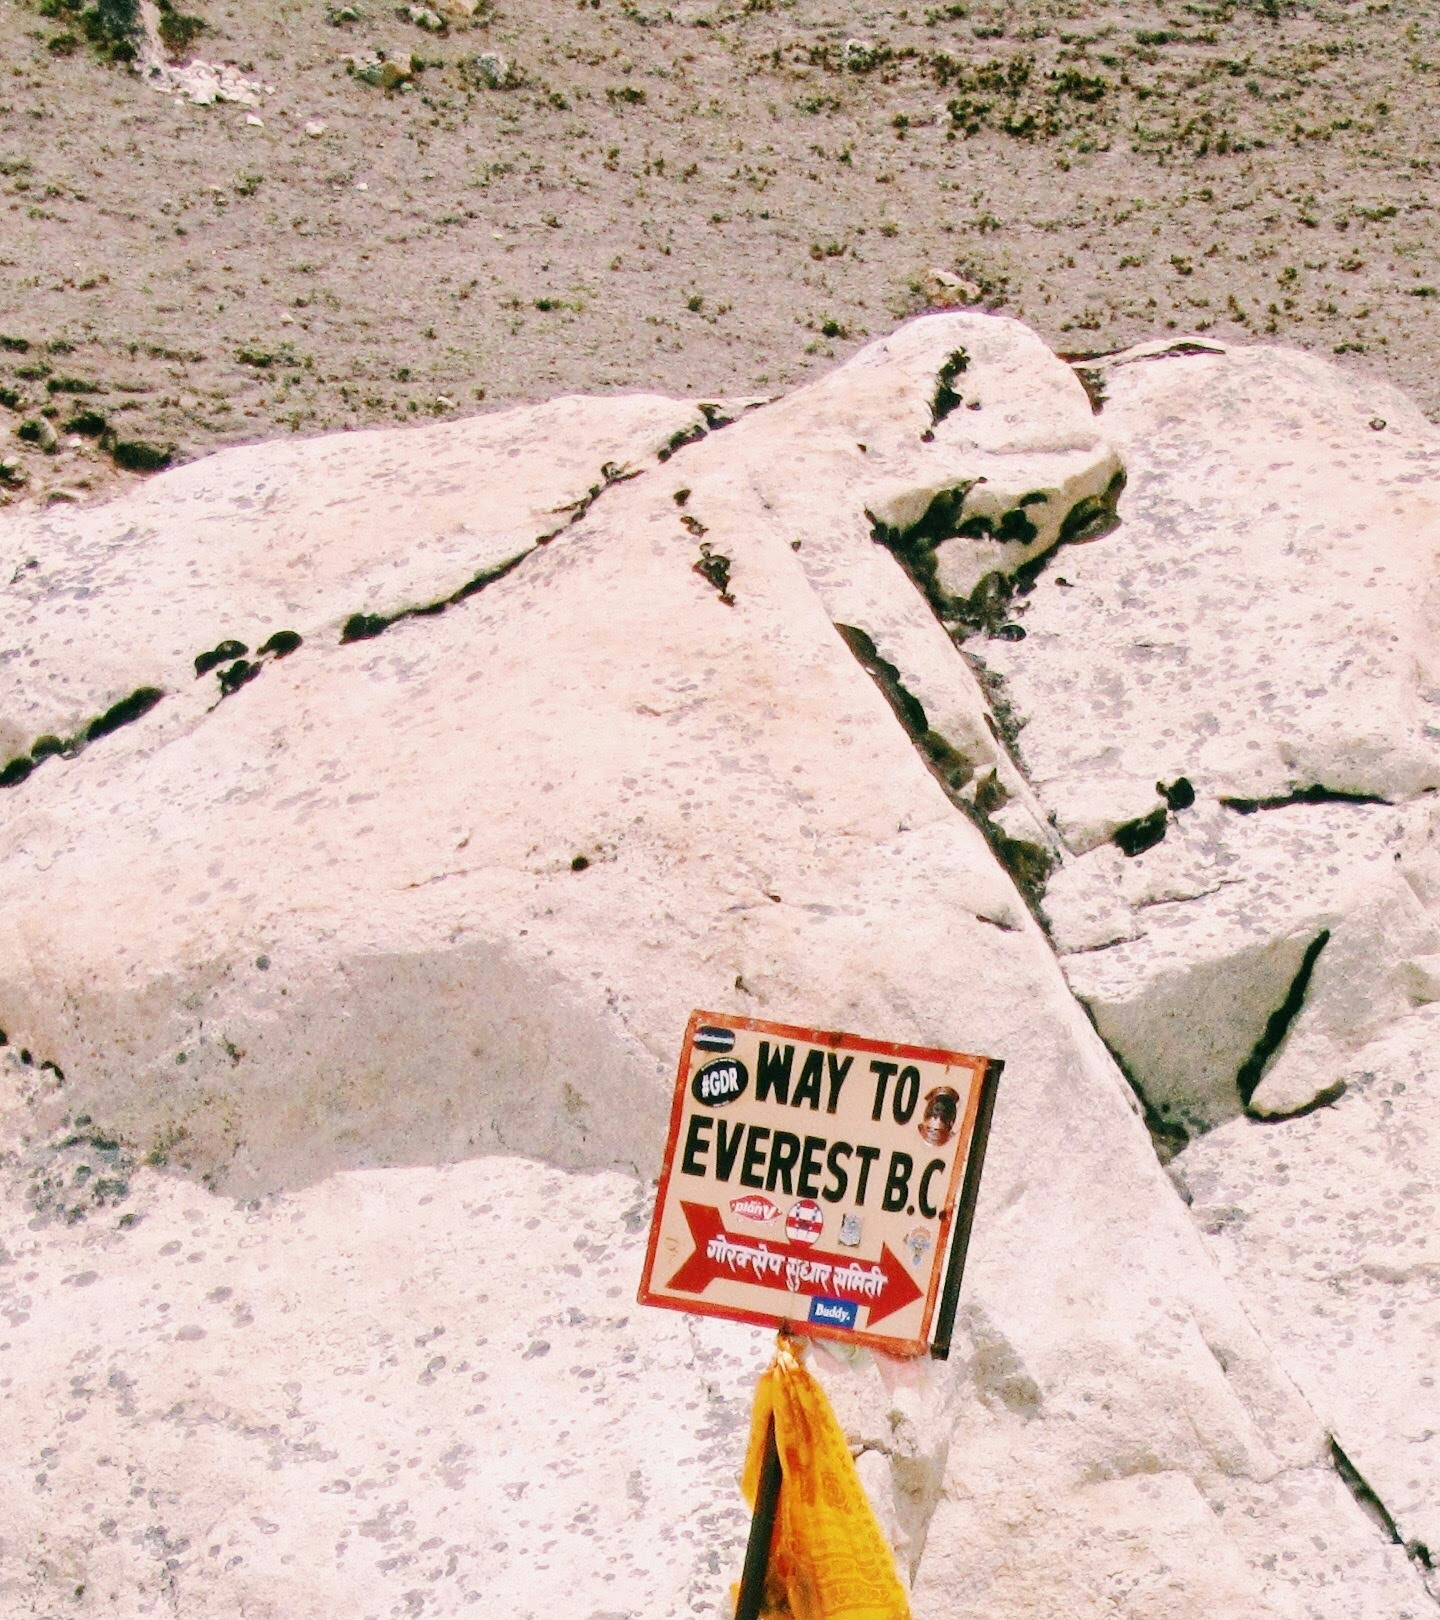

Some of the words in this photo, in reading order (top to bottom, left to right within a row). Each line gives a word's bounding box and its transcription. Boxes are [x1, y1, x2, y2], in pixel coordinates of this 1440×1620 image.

[701, 1067, 739, 1098] #GDR
[755, 1041, 854, 1113] WAY
[870, 1060, 920, 1125] TO
[681, 1114, 880, 1206] EVEREST
